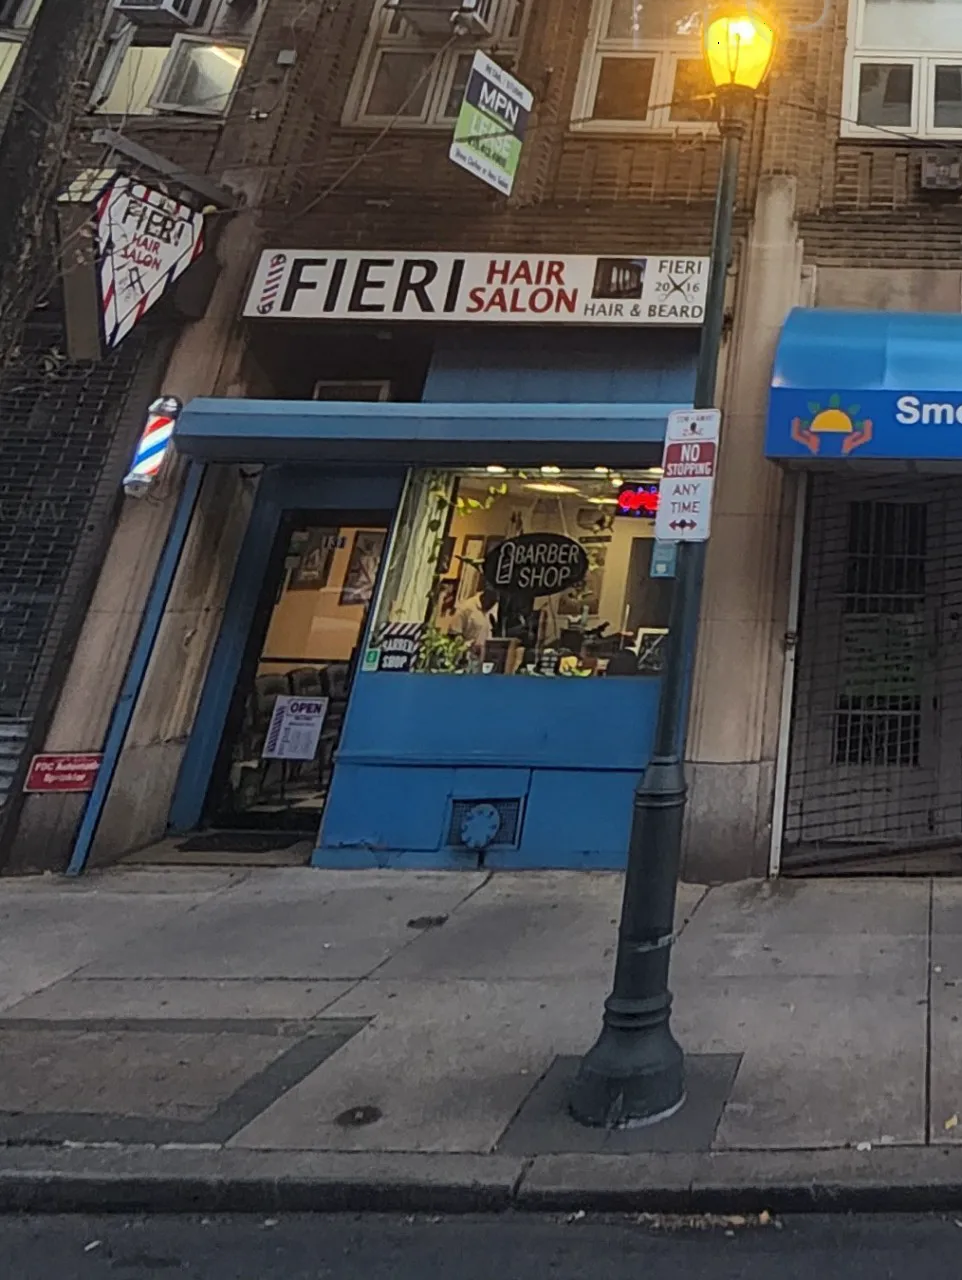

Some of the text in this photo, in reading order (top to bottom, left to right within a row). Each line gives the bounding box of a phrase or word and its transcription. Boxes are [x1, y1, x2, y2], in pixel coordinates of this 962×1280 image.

[479, 81, 519, 124] MPN
[132, 232, 161, 255] HAIR
[486, 260, 565, 285] HAIR
[658, 260, 702, 275] FIERI
[280, 258, 465, 312] FIERI
[466, 287, 578, 313] SALON
[584, 304, 703, 319] HAIR & BEARD
[680, 444, 701, 462] NO
[666, 462, 712, 476] STOPPING
[672, 483, 701, 495] ANY
[618, 489, 661, 510] OPE
[670, 501, 701, 514] TIME
[514, 543, 580, 564] BARBER
[518, 566, 571, 588] SHOP
[382, 655, 408, 669] SHOP
[290, 702, 322, 714] OPEN
